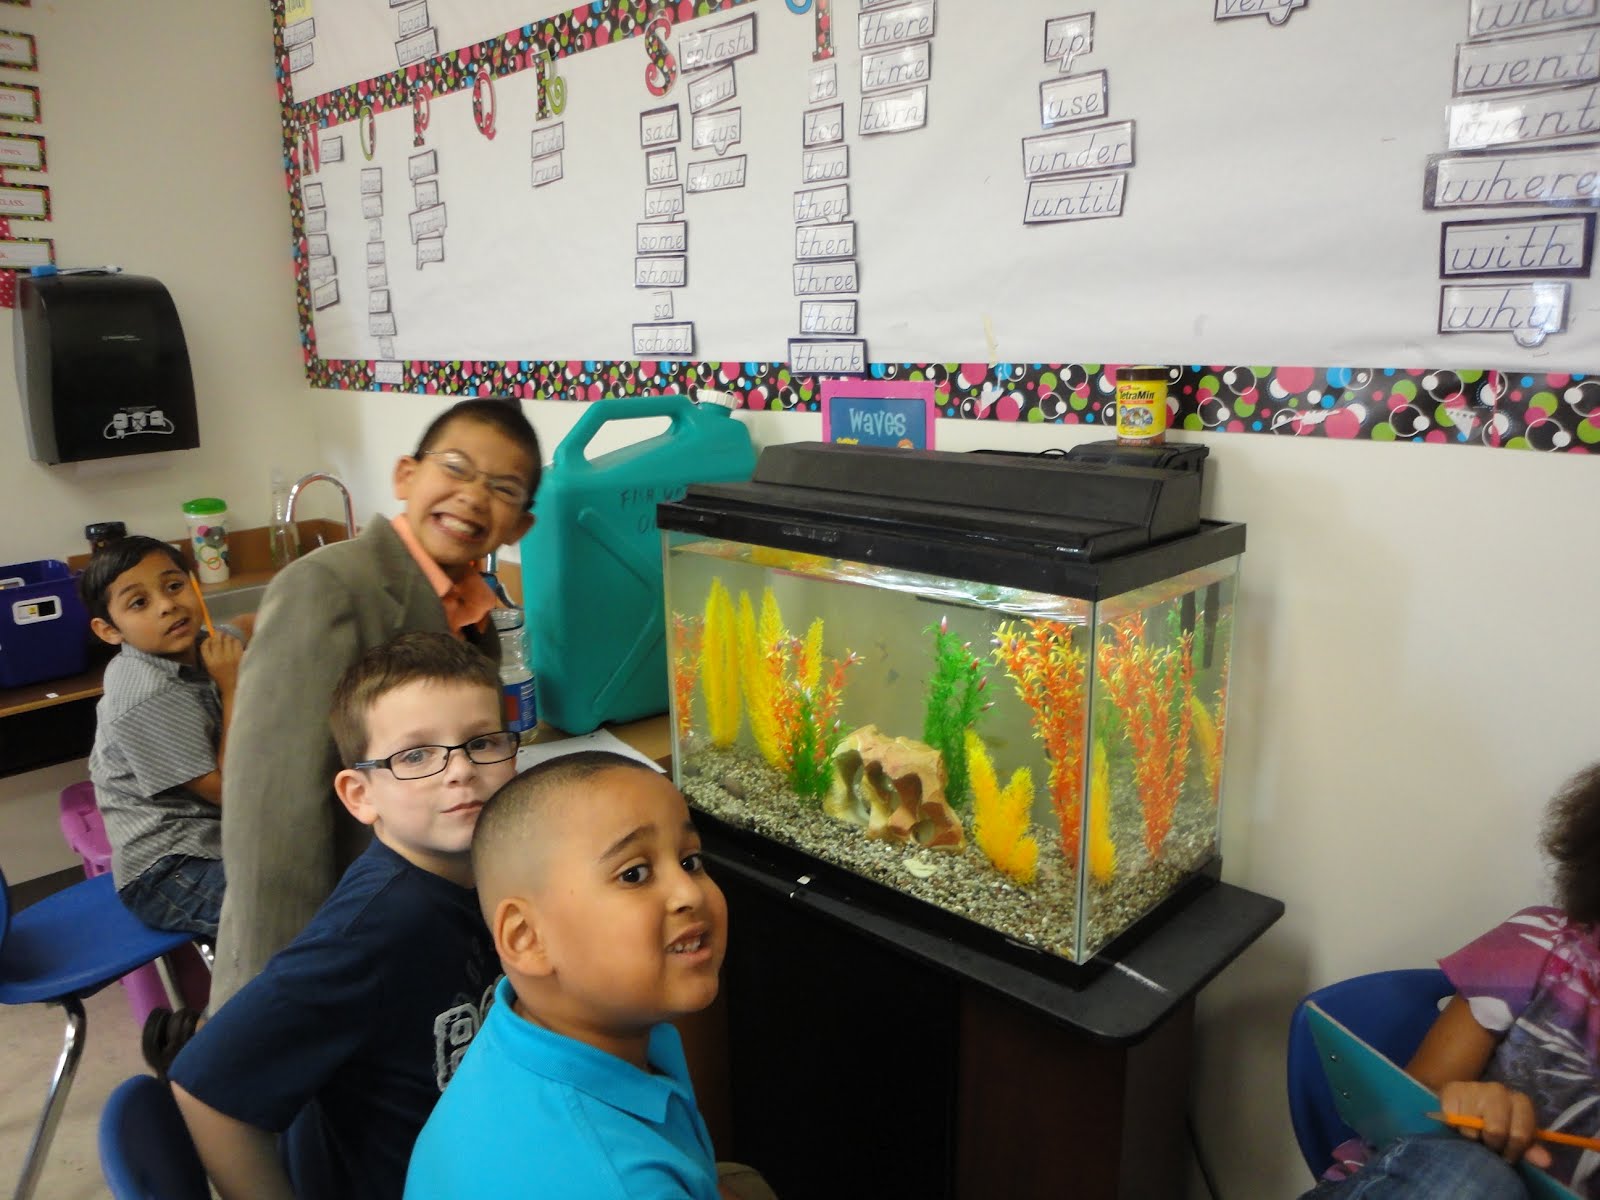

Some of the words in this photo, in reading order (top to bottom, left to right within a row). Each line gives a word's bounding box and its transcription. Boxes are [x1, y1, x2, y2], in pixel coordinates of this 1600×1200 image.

[863, 13, 930, 44] there
[644, 15, 677, 98] S
[687, 25, 751, 67] splash
[1047, 33, 1085, 69] up
[864, 58, 925, 87] time
[1463, 32, 1597, 90] went
[815, 70, 835, 99] to
[1048, 92, 1099, 119] use
[1454, 88, 1599, 146] want
[644, 113, 678, 142] sad
[696, 123, 738, 154] says
[808, 114, 840, 142] too
[805, 153, 844, 180] two
[1028, 133, 1128, 173] under
[533, 161, 562, 184] run
[651, 159, 674, 181] sit
[688, 158, 743, 190] shout
[1441, 160, 1600, 202] where
[647, 190, 681, 221] stop
[794, 193, 846, 222] they
[1031, 179, 1119, 217] until
[639, 233, 683, 250] some
[799, 230, 851, 256] then
[1452, 226, 1573, 269] with
[638, 260, 683, 284] show
[796, 266, 854, 292] three
[654, 303, 670, 318] so
[804, 304, 855, 331] that
[1447, 289, 1554, 347] why
[636, 328, 690, 352] school
[794, 346, 862, 372] think
